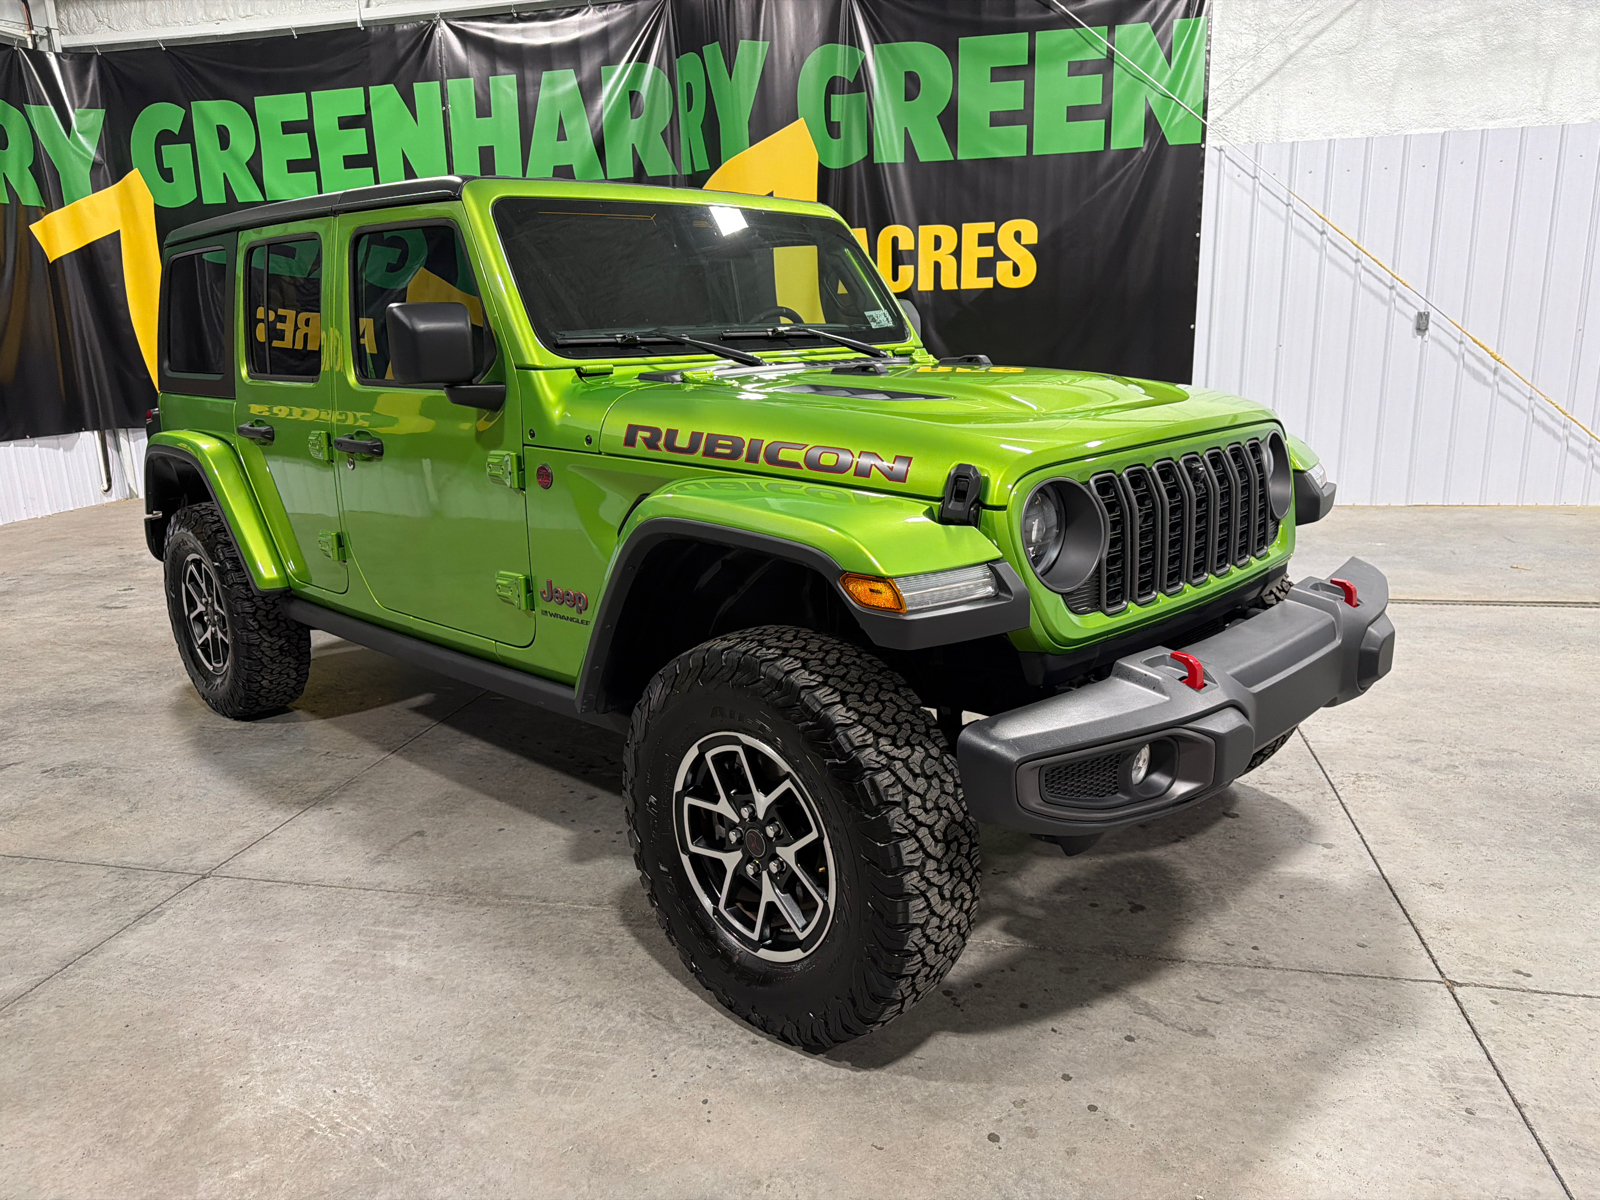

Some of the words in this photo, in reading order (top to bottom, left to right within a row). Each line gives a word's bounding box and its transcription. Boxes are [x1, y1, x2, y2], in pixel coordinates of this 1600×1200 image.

[447, 40, 770, 180] HARRY
[797, 17, 1207, 169] GREEN
[130, 81, 448, 208] GREEN
[623, 424, 913, 483] RUBICON
[540, 579, 589, 615] Jeep
[548, 610, 590, 625] WRANGLER
